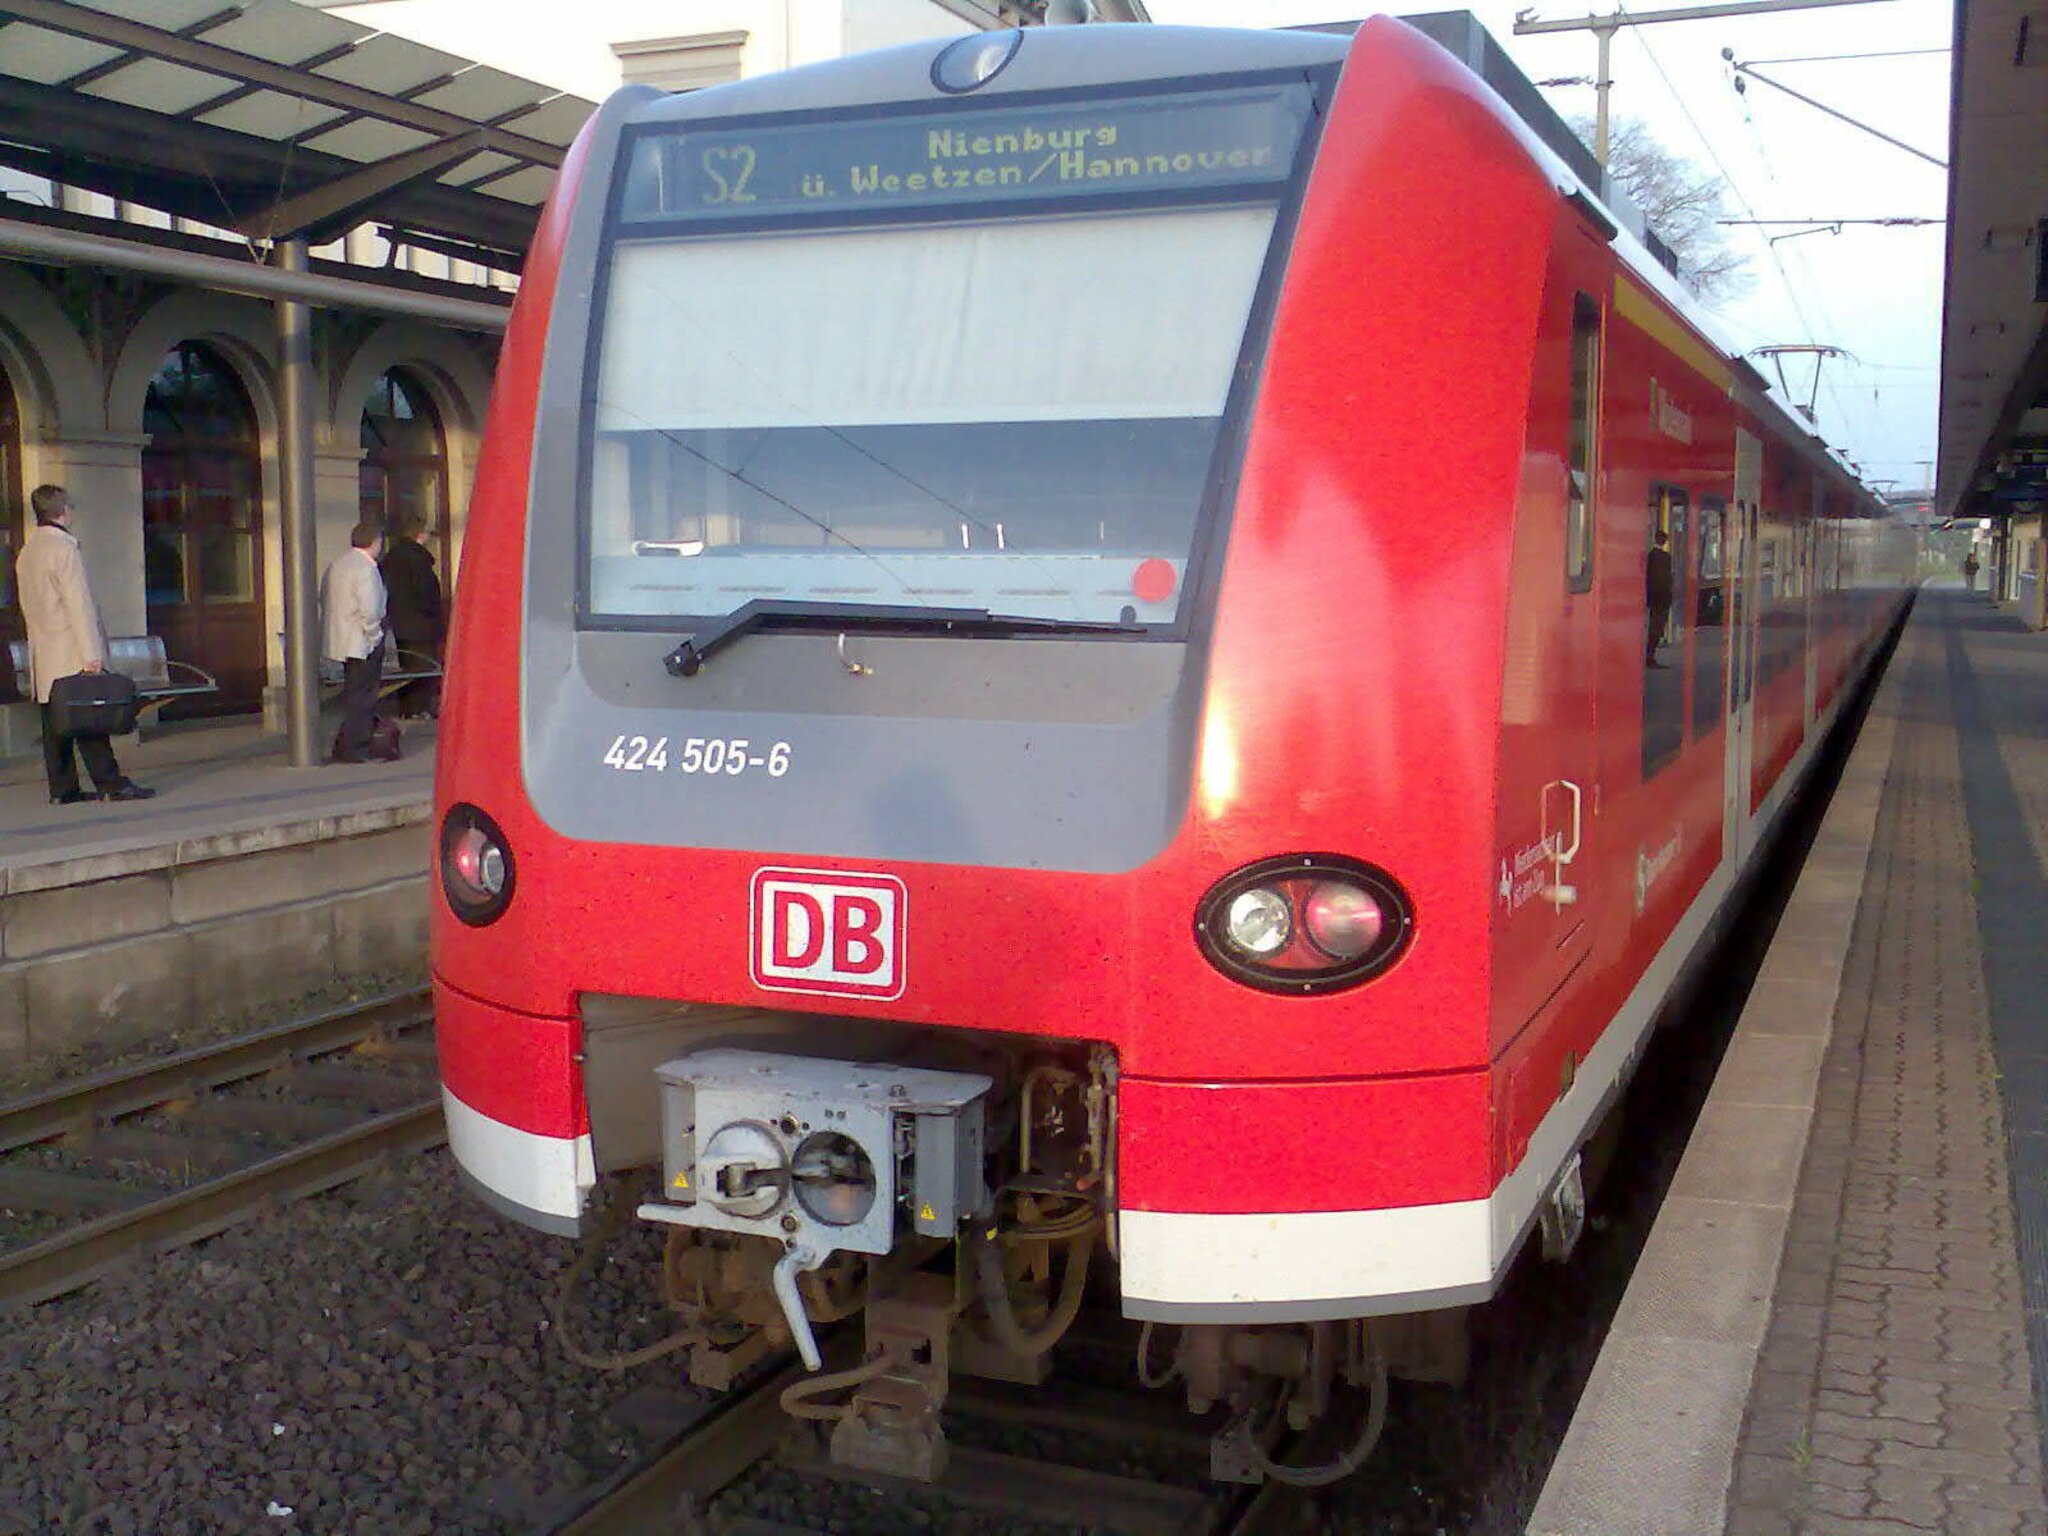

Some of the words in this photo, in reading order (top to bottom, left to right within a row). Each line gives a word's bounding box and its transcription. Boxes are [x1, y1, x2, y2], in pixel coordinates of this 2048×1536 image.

[927, 122, 1118, 159] Nienburg
[702, 144, 757, 203] S2
[603, 734, 668, 772] 424
[681, 737, 792, 777] 505-6
[772, 889, 885, 975] DB
